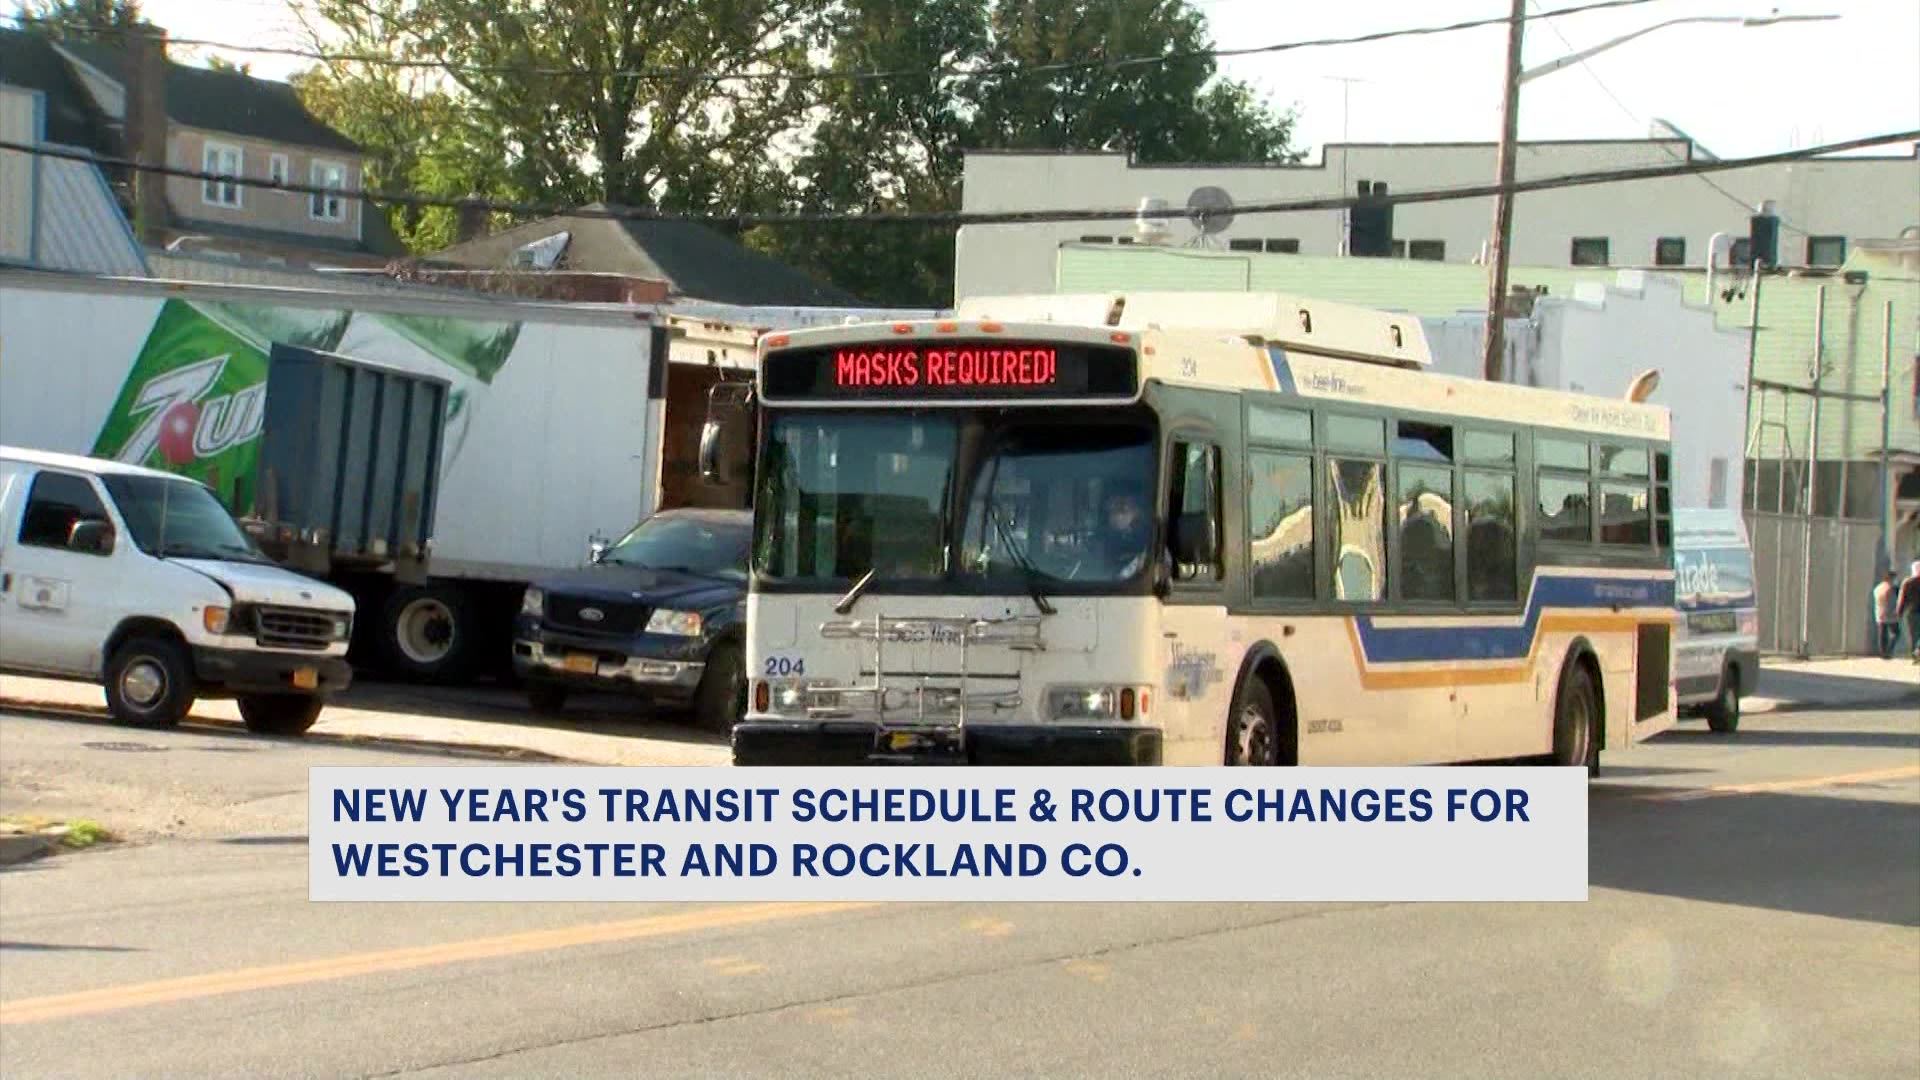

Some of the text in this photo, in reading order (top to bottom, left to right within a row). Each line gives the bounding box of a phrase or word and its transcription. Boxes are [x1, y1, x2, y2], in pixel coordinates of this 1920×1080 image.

[837, 350, 1056, 385] MASKS REQUIRED!
[765, 656, 804, 676] 204
